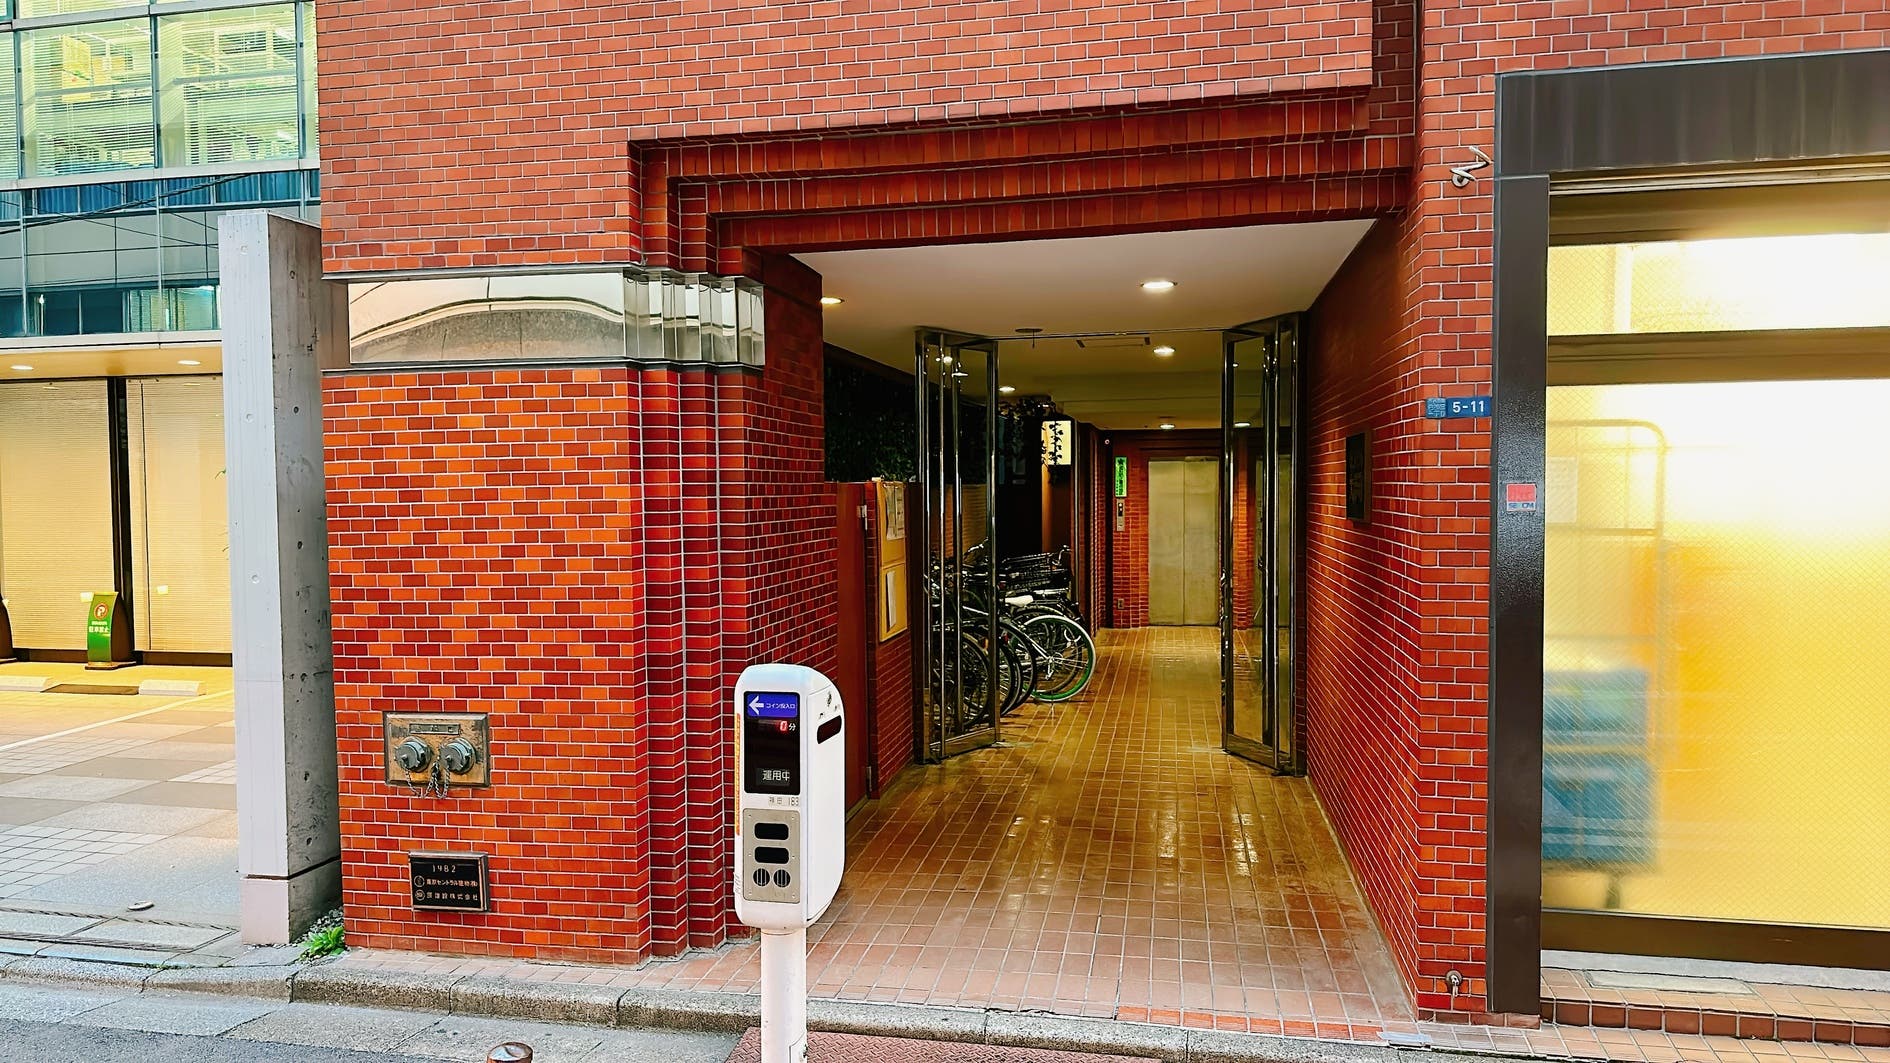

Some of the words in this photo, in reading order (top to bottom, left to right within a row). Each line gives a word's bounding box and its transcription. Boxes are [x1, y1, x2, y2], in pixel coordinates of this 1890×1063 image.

[1452, 400, 1485, 413] 5-11
[762, 770, 791, 781] 運用中
[432, 864, 456, 873] 1982
